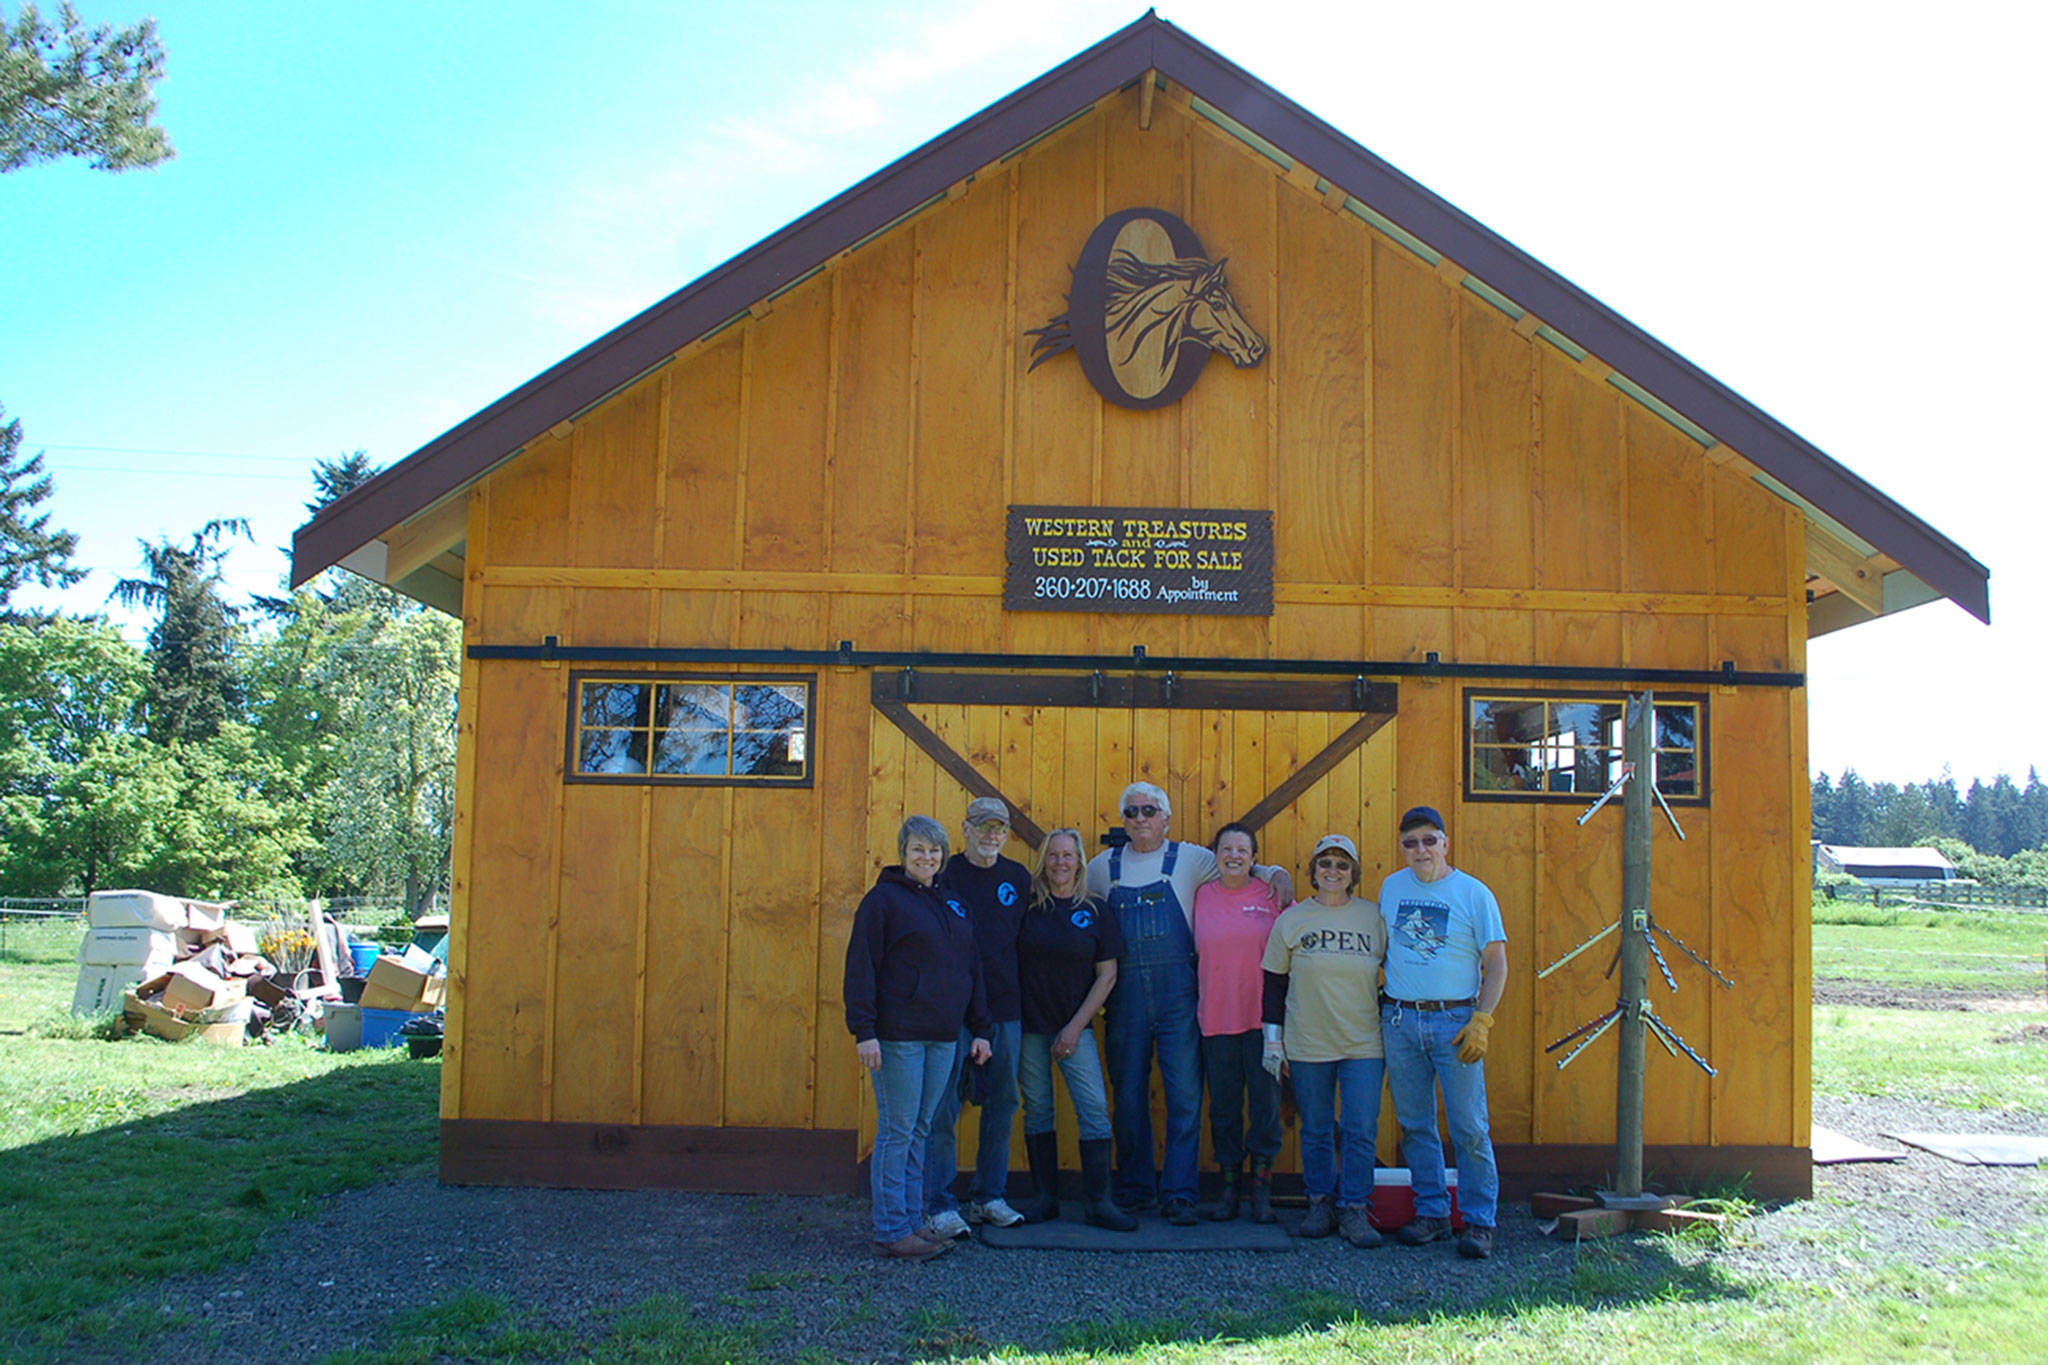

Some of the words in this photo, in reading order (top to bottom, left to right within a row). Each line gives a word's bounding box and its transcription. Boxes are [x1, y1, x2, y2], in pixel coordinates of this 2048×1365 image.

[1025, 518, 1114, 537] WESTERN
[1124, 520, 1248, 541] TREASURES
[1122, 538, 1151, 549] and
[1033, 548, 1085, 568] USED
[1092, 550, 1146, 569] TACK
[1154, 550, 1192, 570] FOR
[1197, 551, 1243, 571] SALE
[1192, 576, 1209, 591] by
[1156, 586, 1238, 604] Appointment
